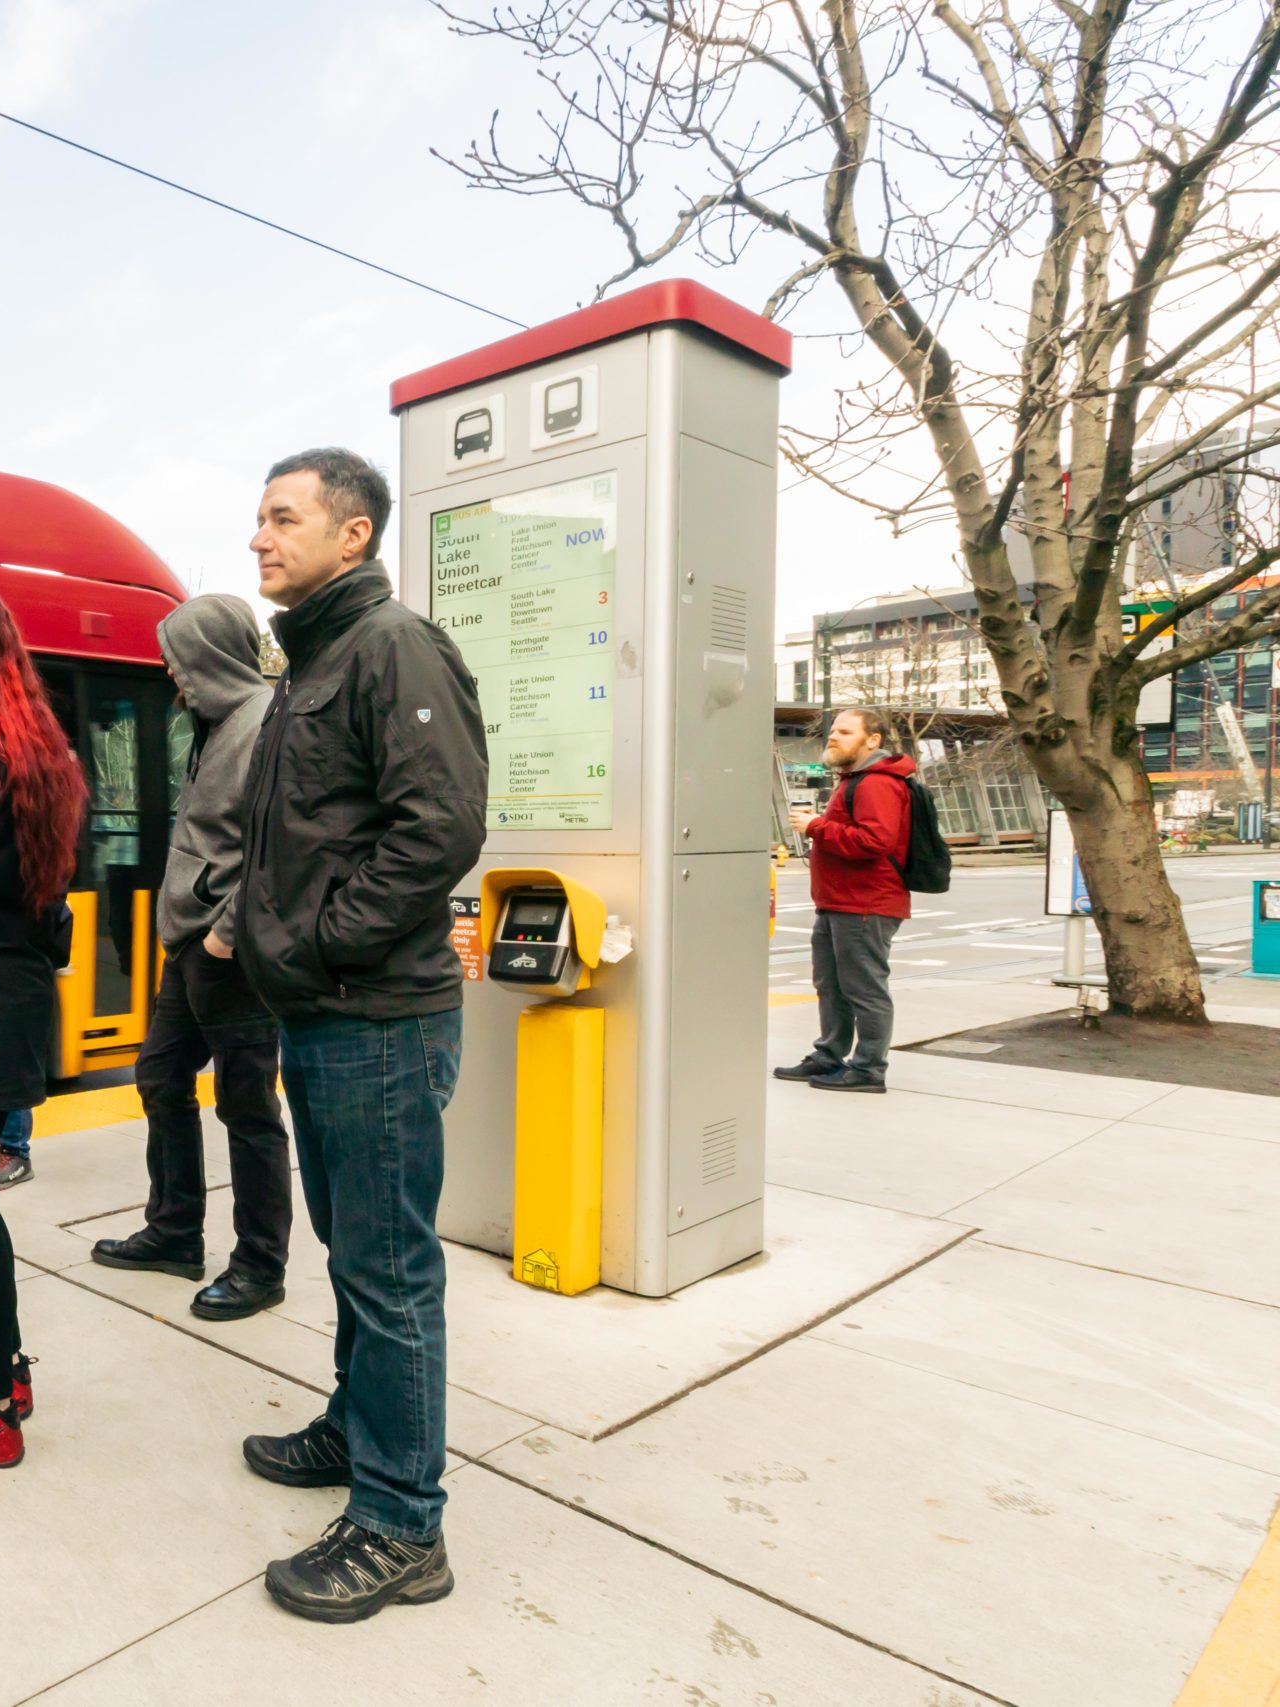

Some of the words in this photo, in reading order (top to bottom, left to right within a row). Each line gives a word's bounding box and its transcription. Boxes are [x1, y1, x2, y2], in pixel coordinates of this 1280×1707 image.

[511, 526, 530, 536] Lake
[532, 521, 557, 533] Union
[511, 534, 530, 544] Fred
[565, 527, 608, 547] NOW
[437, 548, 471, 565] Lake
[511, 550, 540, 562] Cancer
[511, 559, 538, 570] Center
[437, 563, 480, 581] Union
[437, 575, 503, 597] Streetcar
[511, 591, 535, 601] South
[536, 587, 556, 598] Lake
[598, 591, 609, 605] 3
[511, 600, 534, 609] Union
[510, 605, 553, 618] Downtown
[437, 618, 447, 630] C
[451, 613, 483, 628] Line
[510, 615, 538, 626] Seattle
[510, 635, 550, 647] Northgate
[588, 630, 608, 646] 10
[510, 644, 544, 655] Fremont
[510, 677, 529, 686] Lake
[531, 674, 555, 684] Union
[510, 685, 528, 694] Fred
[588, 685, 607, 700] 11
[510, 691, 551, 702] Hutchison
[510, 702, 538, 711] Cancer
[510, 710, 536, 719] Center
[509, 752, 528, 760] Lake
[530, 750, 554, 759] Union
[509, 760, 527, 768] Fred
[509, 767, 550, 777] Hutchison
[586, 764, 606, 778] 16
[509, 776, 537, 785] Cancer
[509, 785, 536, 793] Center
[508, 812, 535, 821] SDOT
